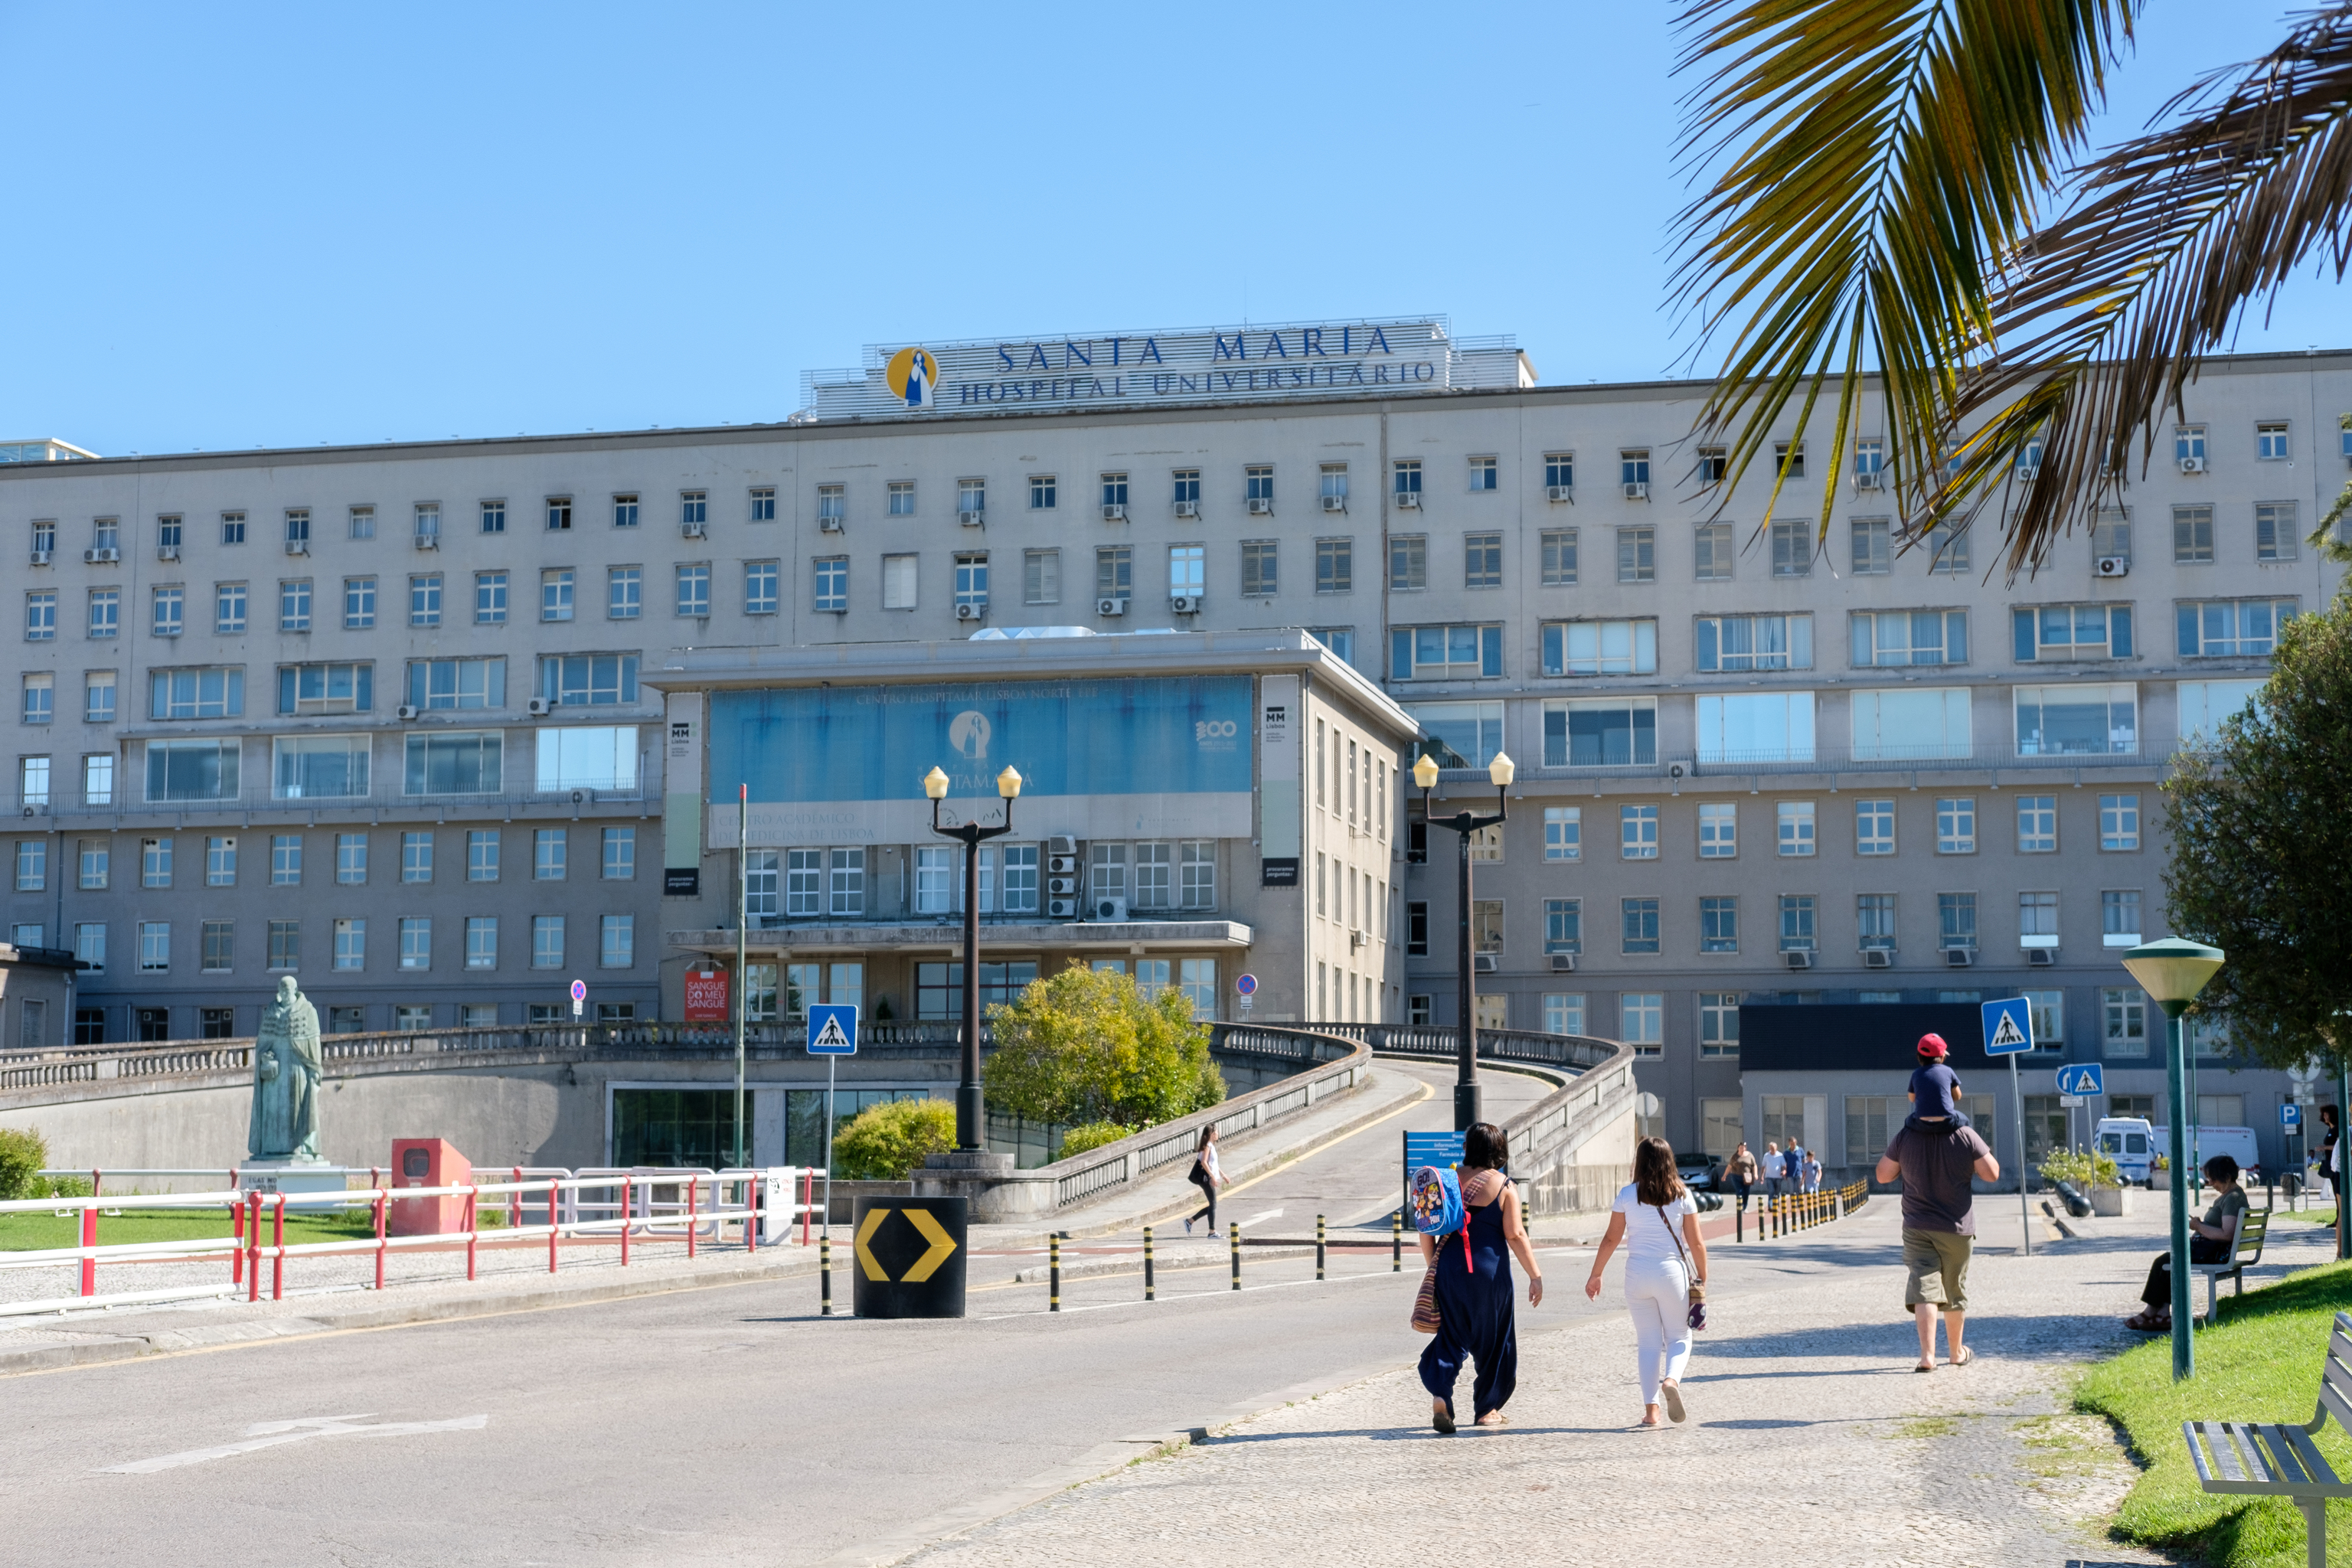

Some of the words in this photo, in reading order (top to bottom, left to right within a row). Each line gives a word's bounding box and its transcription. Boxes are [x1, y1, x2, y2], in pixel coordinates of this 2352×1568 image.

[997, 337, 1163, 373] SANTA
[1213, 325, 1392, 361] MARIA
[959, 375, 1127, 403] HOSPITAL
[856, 694, 906, 705] CENTRO
[910, 691, 983, 704] HOSPITALAR
[987, 691, 1027, 702] LISBOA
[1031, 688, 1071, 700] NORTE
[809, 829, 825, 840] DE
[830, 828, 875, 840] LISBOA
[688, 982, 725, 991] SANGUE
[688, 991, 703, 999] DO
[704, 991, 725, 999] MEU
[687, 999, 725, 1008] SANGUE
[2283, 1106, 2296, 1122] P
[1417, 1171, 1430, 1186] GO!
